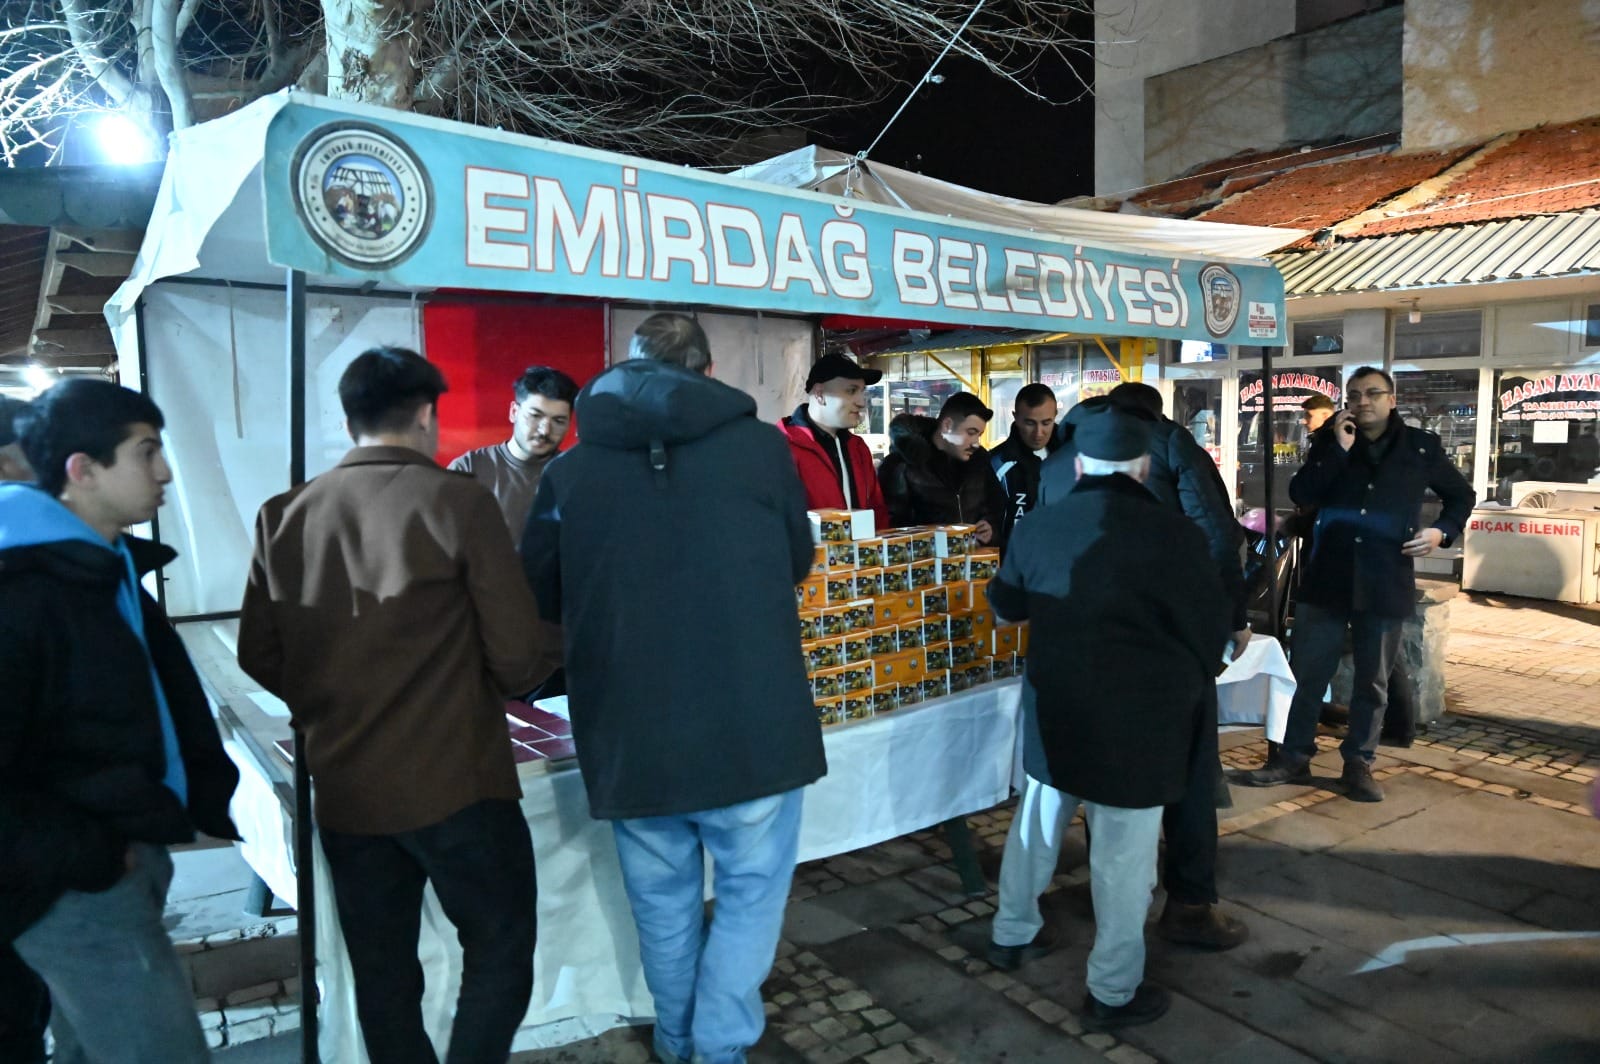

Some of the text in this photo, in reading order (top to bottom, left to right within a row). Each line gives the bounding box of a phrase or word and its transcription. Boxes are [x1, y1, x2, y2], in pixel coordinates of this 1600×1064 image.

[465, 165, 1190, 328] EMİRDAĞ BELEDİYESİ
[1240, 374, 1279, 404] HASN
[1500, 375, 1557, 411] HASAN
[1014, 493, 1027, 526] ZA
[1470, 520, 1581, 536] BIÇAK BİLENİR
